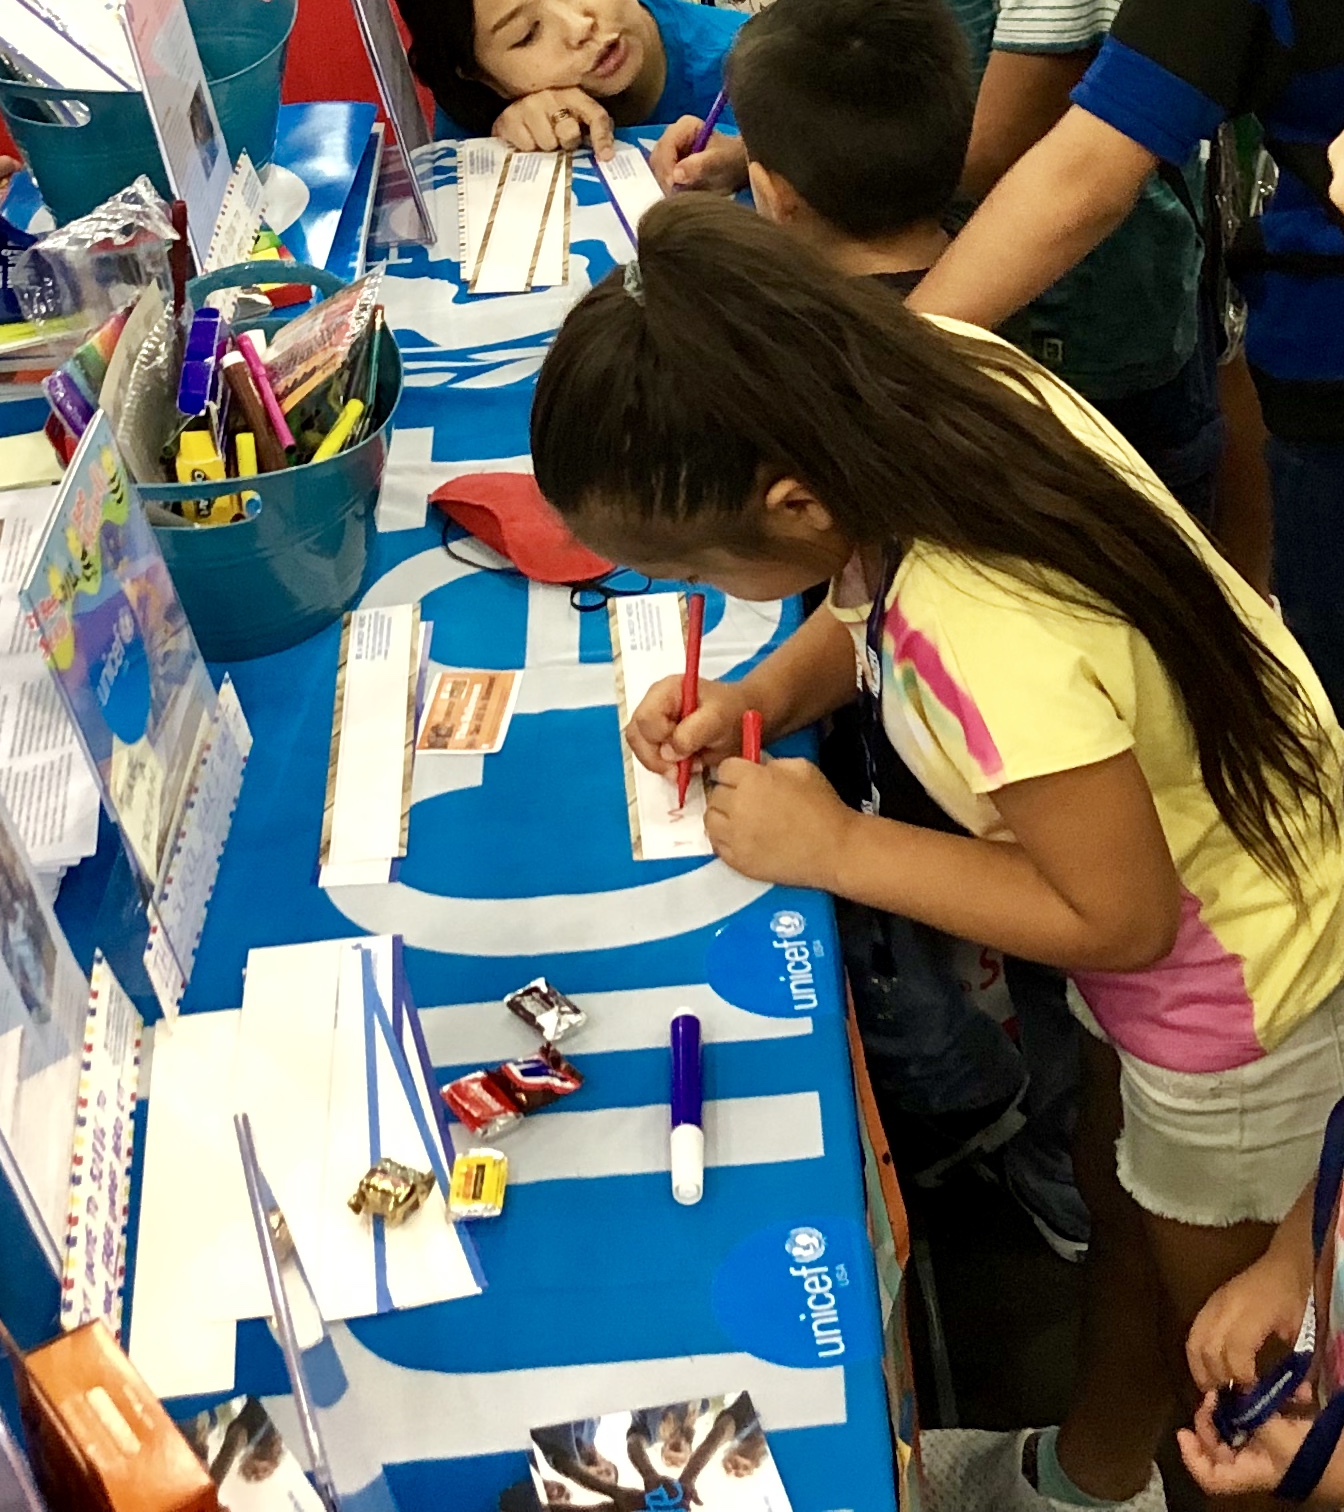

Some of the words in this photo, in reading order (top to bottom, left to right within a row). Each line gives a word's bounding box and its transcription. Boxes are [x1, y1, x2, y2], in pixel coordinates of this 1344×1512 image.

[97, 624, 125, 707] unicef
[773, 935, 819, 1011] unicef
[790, 1264, 846, 1360] unicef
[835, 1263, 849, 1287] USA
